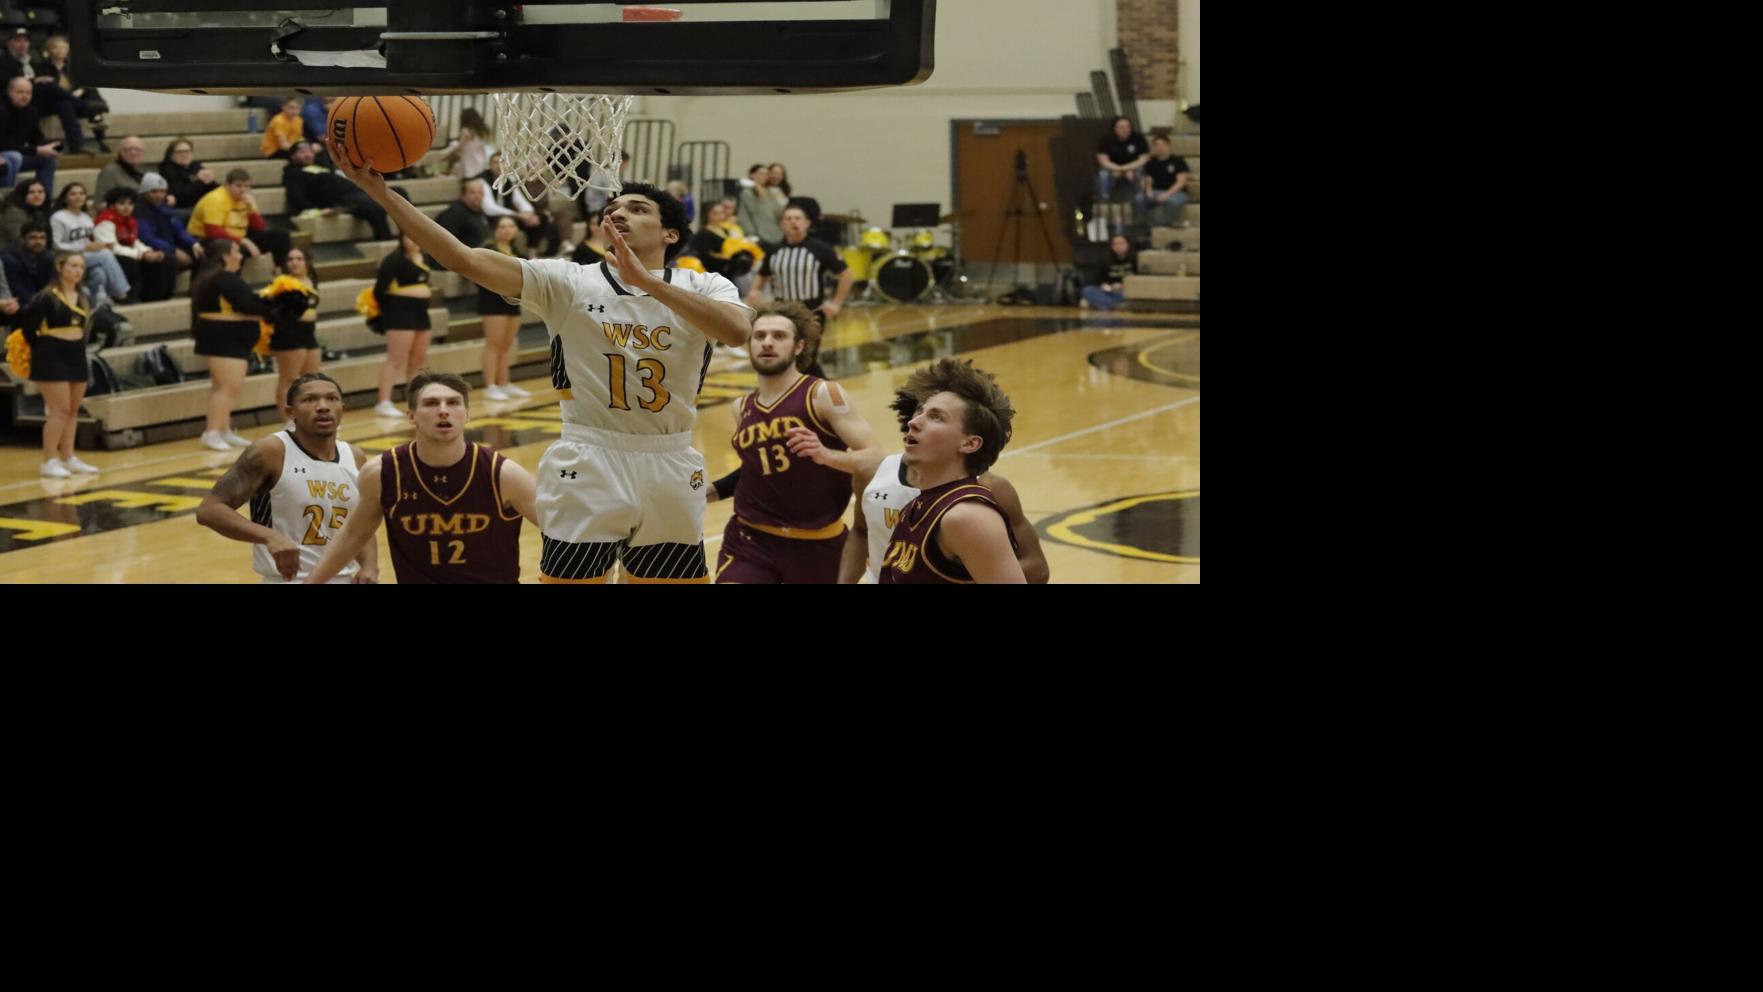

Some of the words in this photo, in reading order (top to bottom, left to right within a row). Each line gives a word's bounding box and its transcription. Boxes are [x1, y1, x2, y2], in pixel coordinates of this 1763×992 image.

[602, 321, 672, 351] WSC
[603, 353, 671, 413] 13
[739, 416, 806, 449] UMD
[758, 444, 791, 475] 13
[306, 479, 351, 502] WSC
[400, 513, 490, 535] UMD
[429, 540, 467, 565] 12
